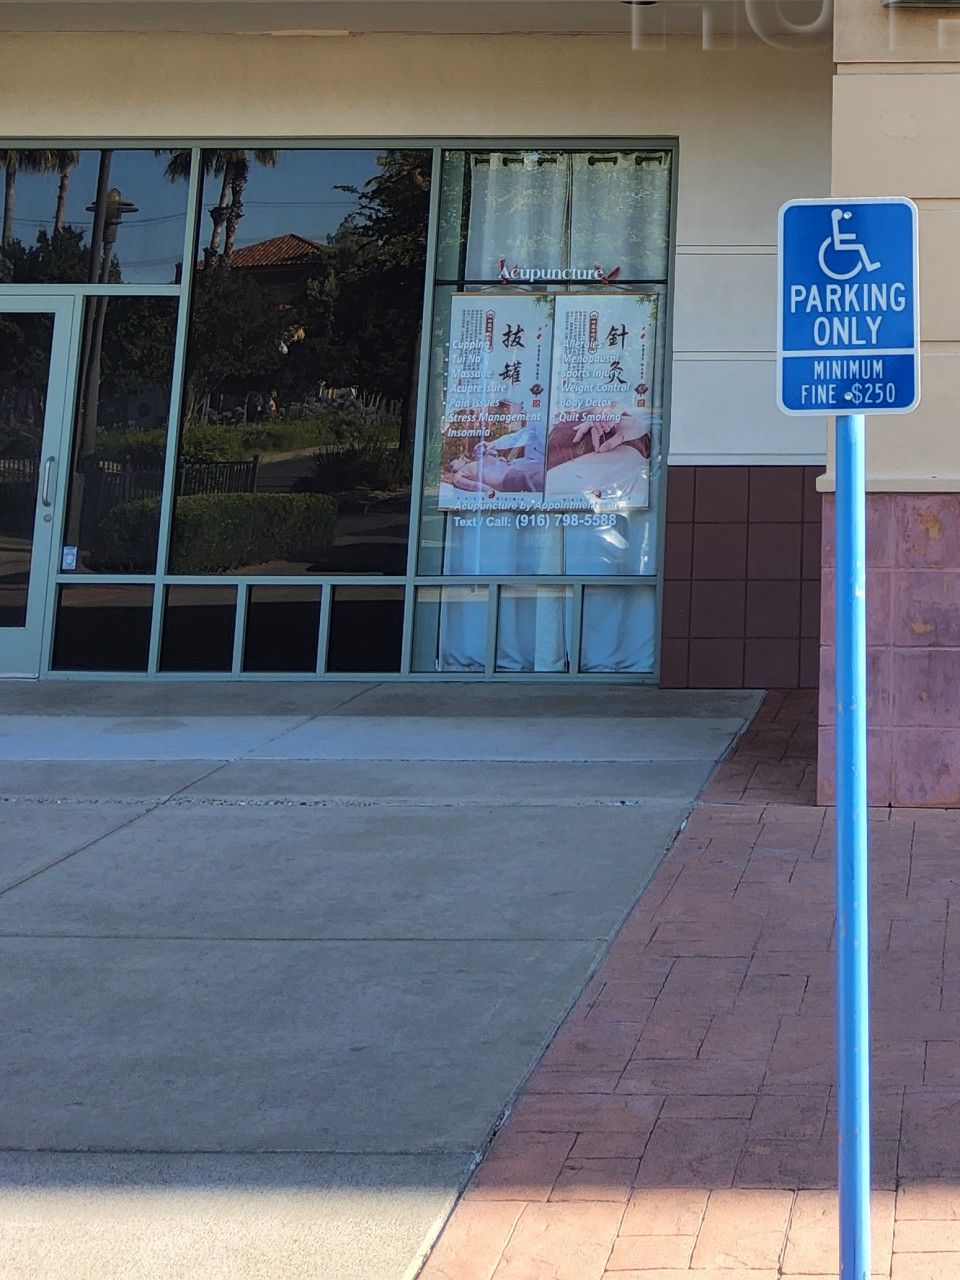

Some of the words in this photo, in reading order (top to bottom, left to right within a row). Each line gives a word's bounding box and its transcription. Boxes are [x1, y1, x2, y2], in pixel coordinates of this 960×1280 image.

[498, 266, 604, 283] Acupuncture
[790, 282, 907, 313] PARKING
[813, 315, 883, 346] ONLY
[452, 339, 490, 353] Cupping
[562, 340, 603, 351] Allergies
[561, 355, 620, 365] Menopausal
[450, 369, 492, 380] Massage
[813, 360, 884, 380] MINIMUM
[449, 384, 507, 394] Acupressure
[561, 384, 595, 394] Weight
[596, 384, 631, 393] Control
[801, 384, 837, 405] FINE
[851, 382, 896, 405] $250
[448, 398, 470, 407] Pain
[585, 398, 613, 408] Detox
[447, 412, 476, 423] Stress
[478, 412, 542, 424] Management
[559, 412, 579, 423] Quit
[582, 412, 622, 424] Smoking
[447, 427, 491, 438] Insomnia
[454, 500, 520, 511] Acupuncture
[522, 500, 532, 512] by
[534, 500, 597, 512] Appointmen
[453, 516, 477, 528] Text
[486, 517, 512, 528] Call:
[515, 514, 549, 530] (916)
[554, 514, 618, 528] 798-5588
